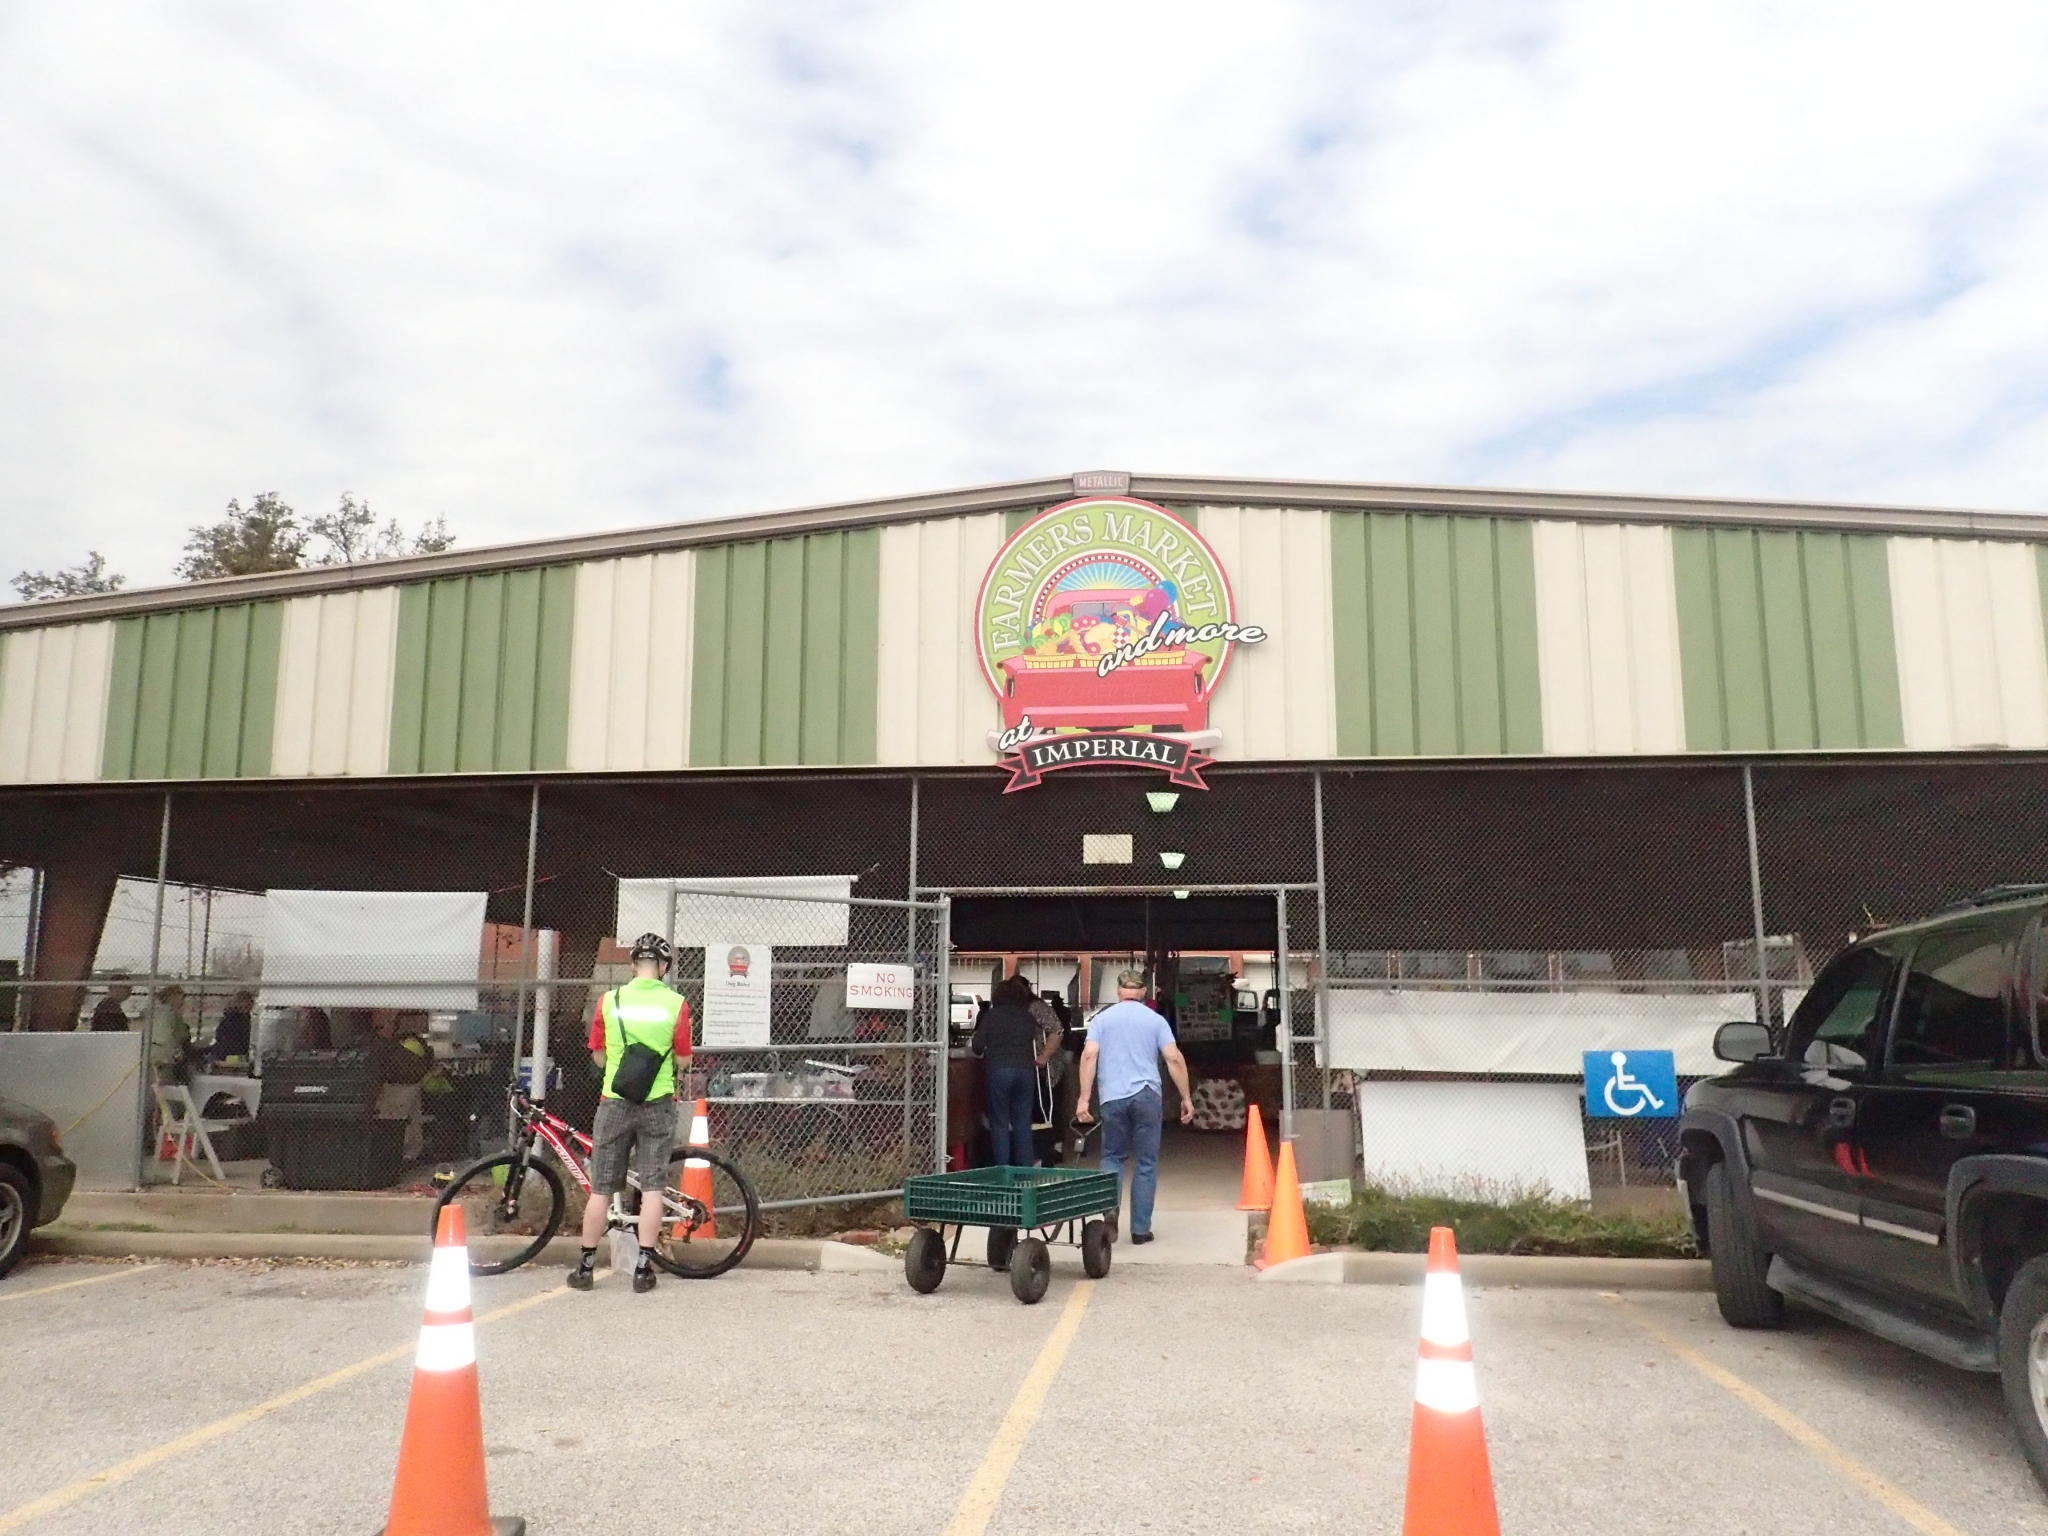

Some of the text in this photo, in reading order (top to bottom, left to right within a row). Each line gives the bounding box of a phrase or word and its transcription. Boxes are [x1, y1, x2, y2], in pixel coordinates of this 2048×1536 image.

[1079, 475, 1123, 488] METALLIC
[992, 511, 1218, 653] FARMERS MARKET
[1098, 610, 1267, 678] and more
[998, 714, 1033, 751] at
[1031, 738, 1178, 768] IMPERIAL
[849, 985, 913, 998] SMOKING
[876, 972, 896, 984] NO
